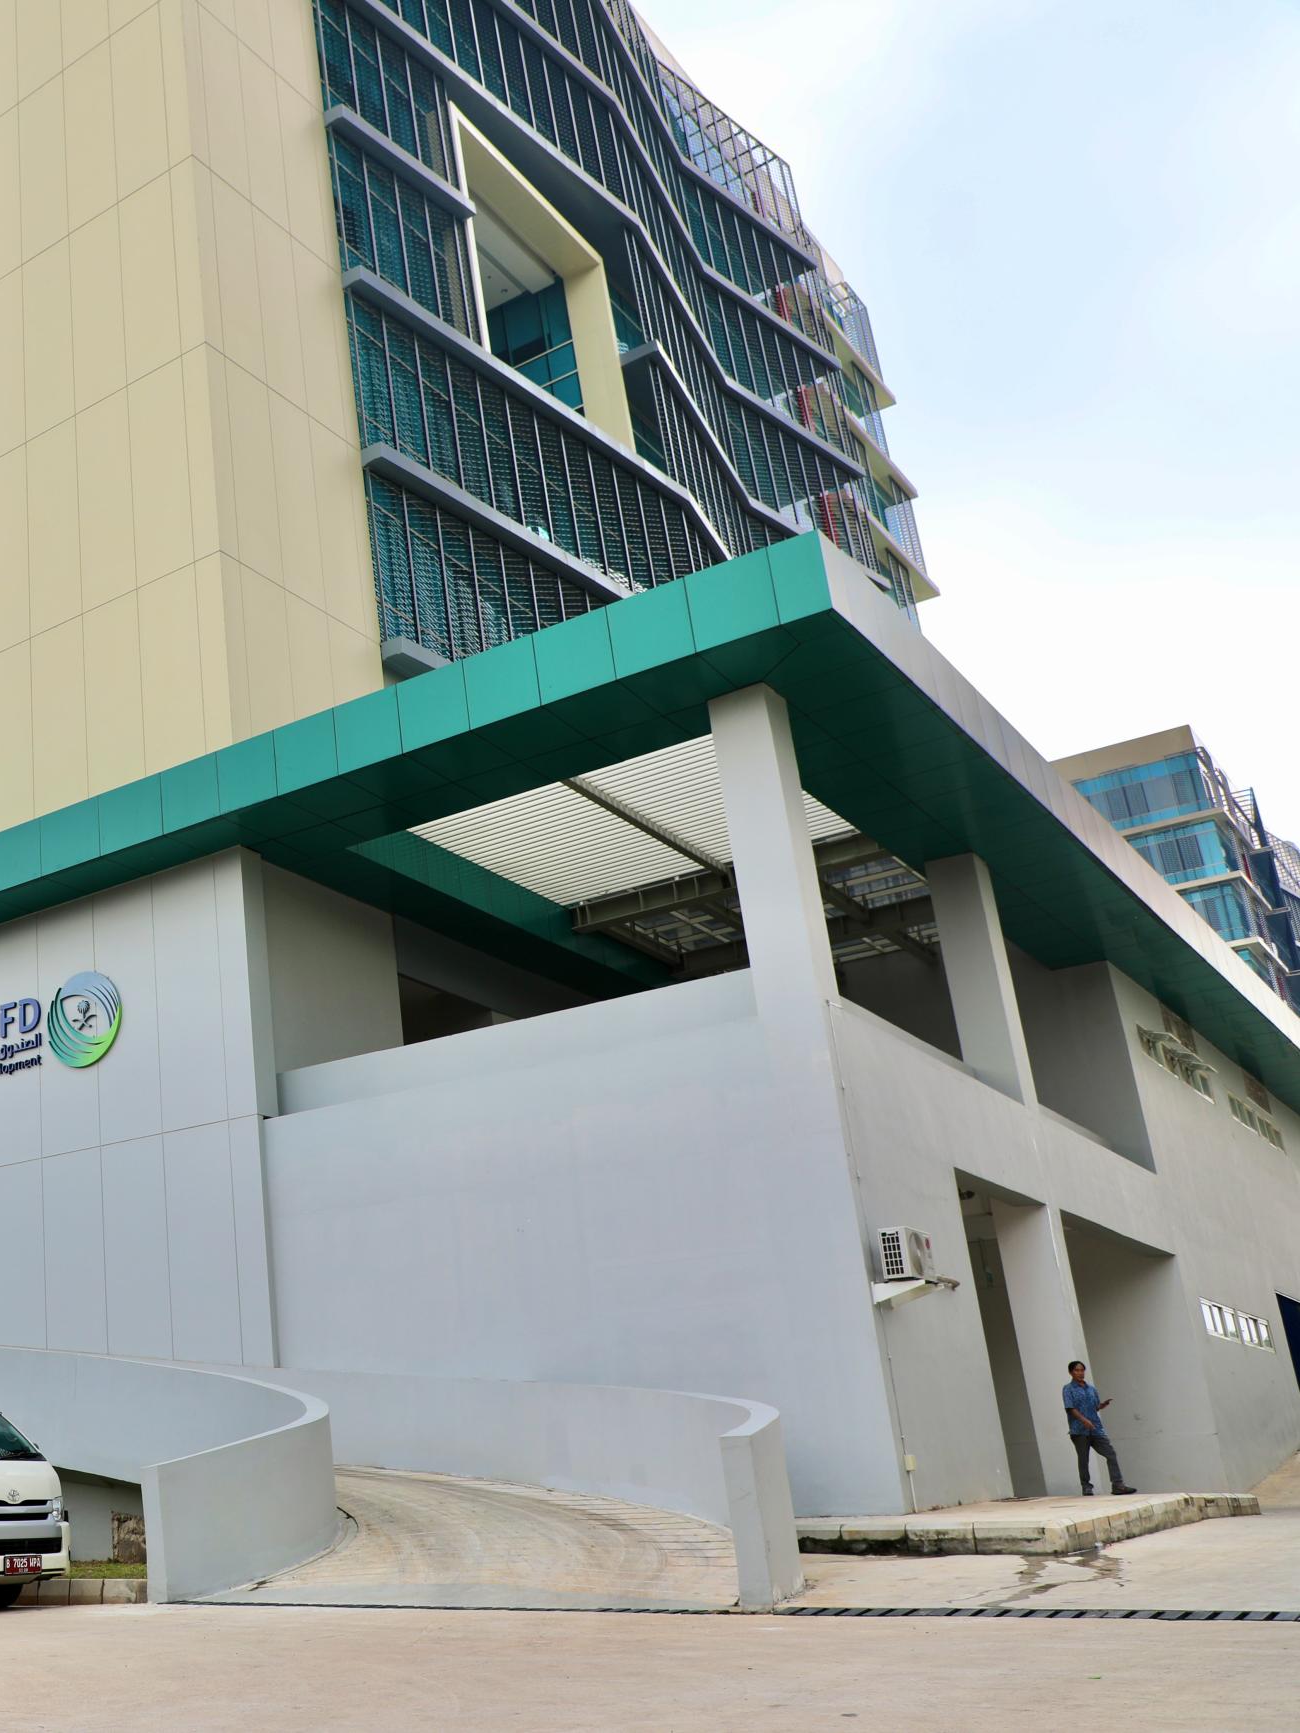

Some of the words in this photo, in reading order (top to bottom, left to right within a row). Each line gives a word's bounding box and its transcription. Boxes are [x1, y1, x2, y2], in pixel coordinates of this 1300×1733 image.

[6, 1558, 11, 1569] B
[13, 1558, 28, 1568] 7025
[29, 1557, 41, 1568] WPA
